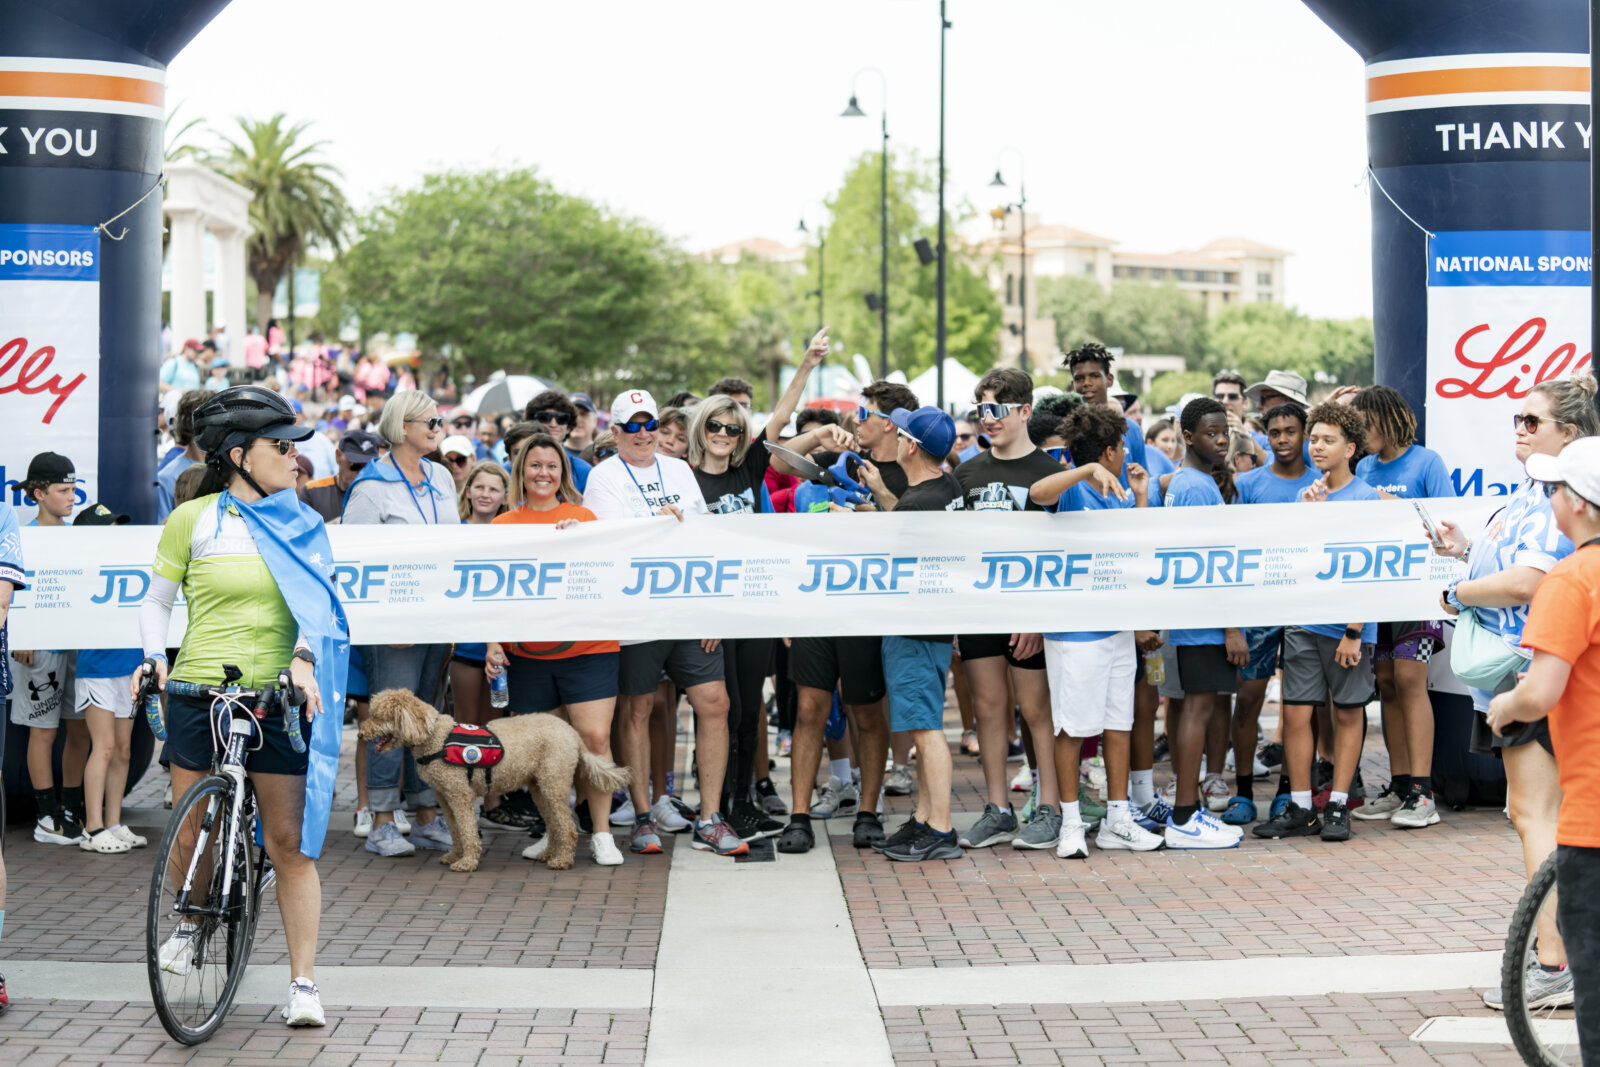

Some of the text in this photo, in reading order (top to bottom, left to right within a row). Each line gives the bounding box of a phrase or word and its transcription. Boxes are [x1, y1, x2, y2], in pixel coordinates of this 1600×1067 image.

[20, 127, 98, 157] YOU
[1435, 121, 1566, 151] THANK
[0, 249, 94, 267] PONSORS
[1436, 256, 1534, 272] NATIONAL
[631, 392, 643, 404] C
[639, 482, 660, 493] EAT
[646, 494, 680, 507] SLEEP
[921, 555, 966, 563] IMPROVING
[1265, 546, 1309, 554] IMPROVING
[1315, 543, 1430, 581] JDRF
[335, 564, 390, 600] RF
[392, 563, 438, 571] IMPROVING
[444, 562, 567, 599] JDRF
[621, 559, 743, 596] JDRF
[798, 556, 919, 593] JDRF
[973, 553, 1093, 590] JDRF
[1146, 548, 1264, 586] JDRF
[90, 569, 151, 605] JD
[33, 688, 63, 710] UNDER
